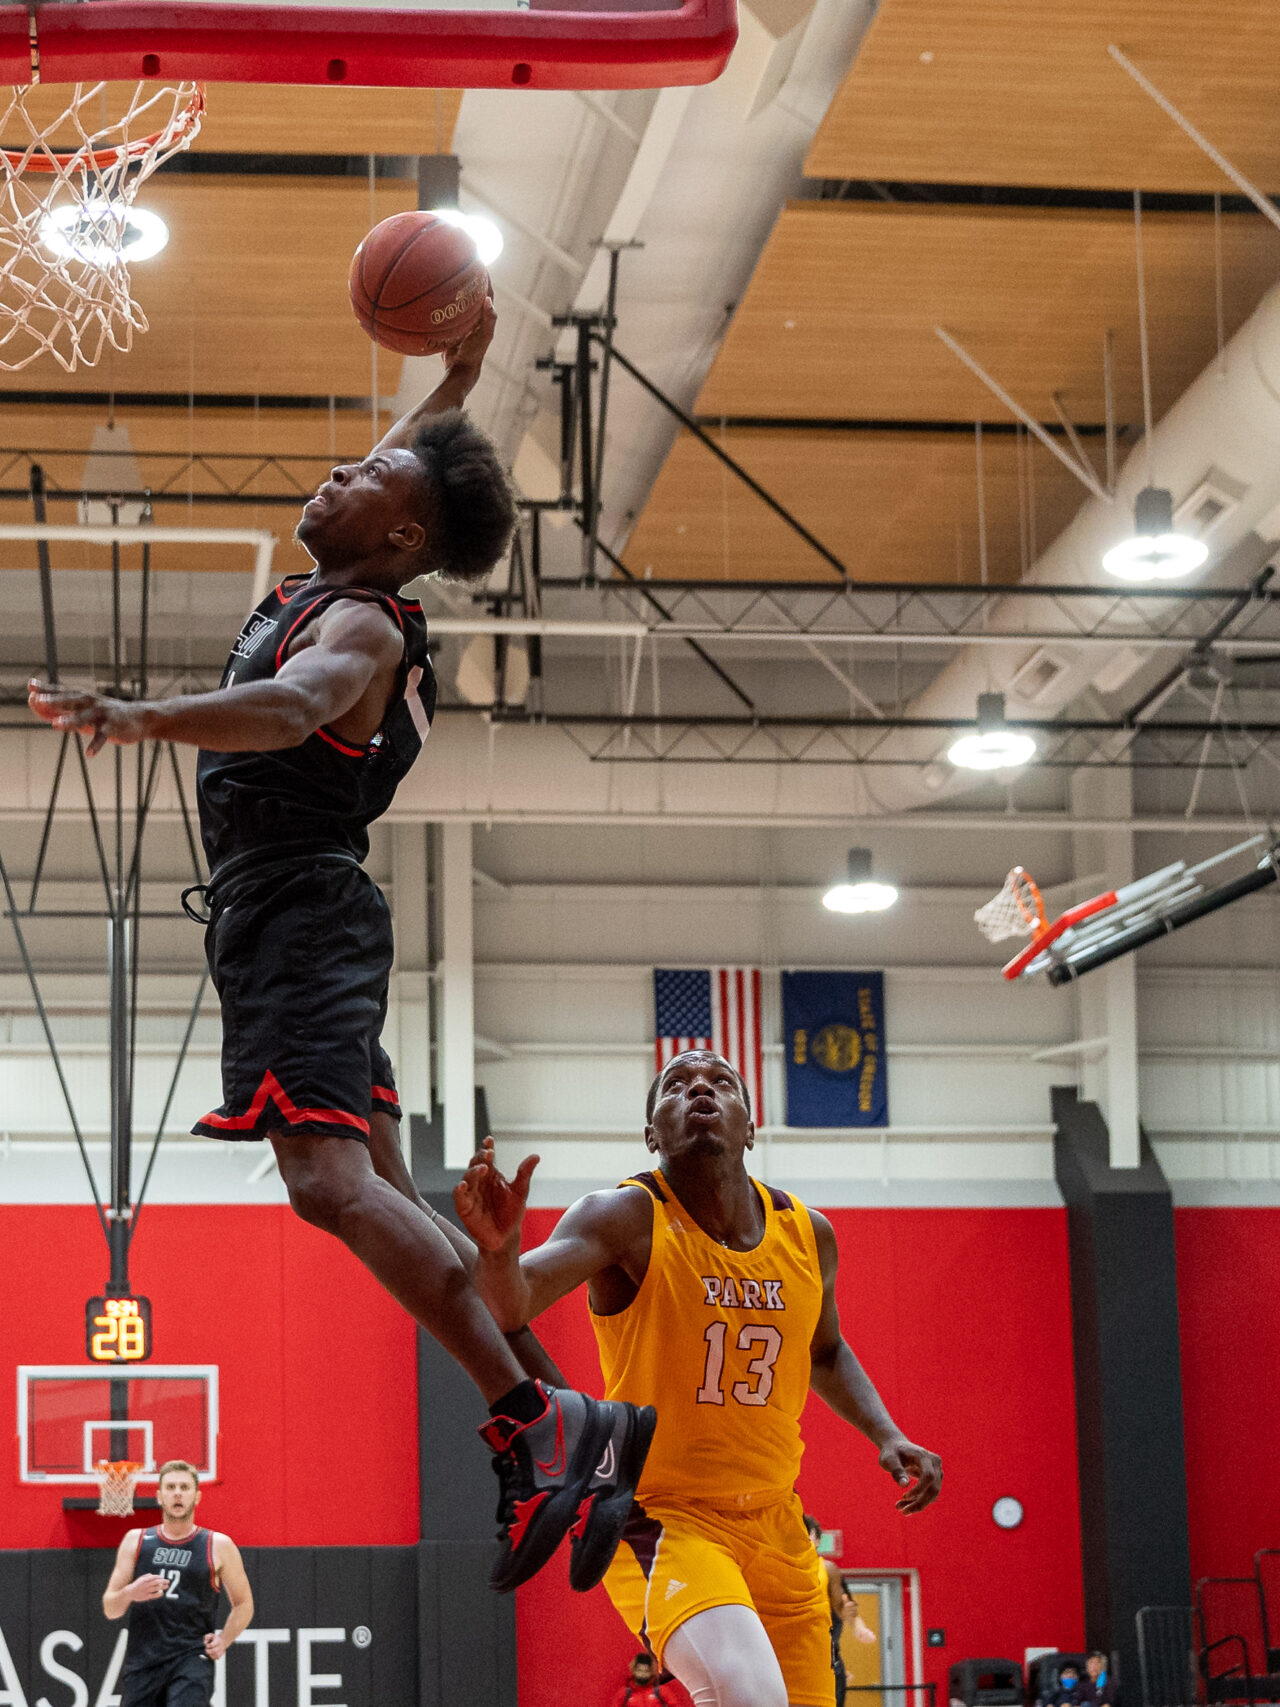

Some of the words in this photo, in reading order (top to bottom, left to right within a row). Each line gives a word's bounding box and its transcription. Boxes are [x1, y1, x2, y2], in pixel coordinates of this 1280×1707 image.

[701, 1276, 786, 1311] PARK
[91, 1315, 145, 1360] 28
[696, 1320, 783, 1407] 13
[152, 1546, 192, 1567] SOU
